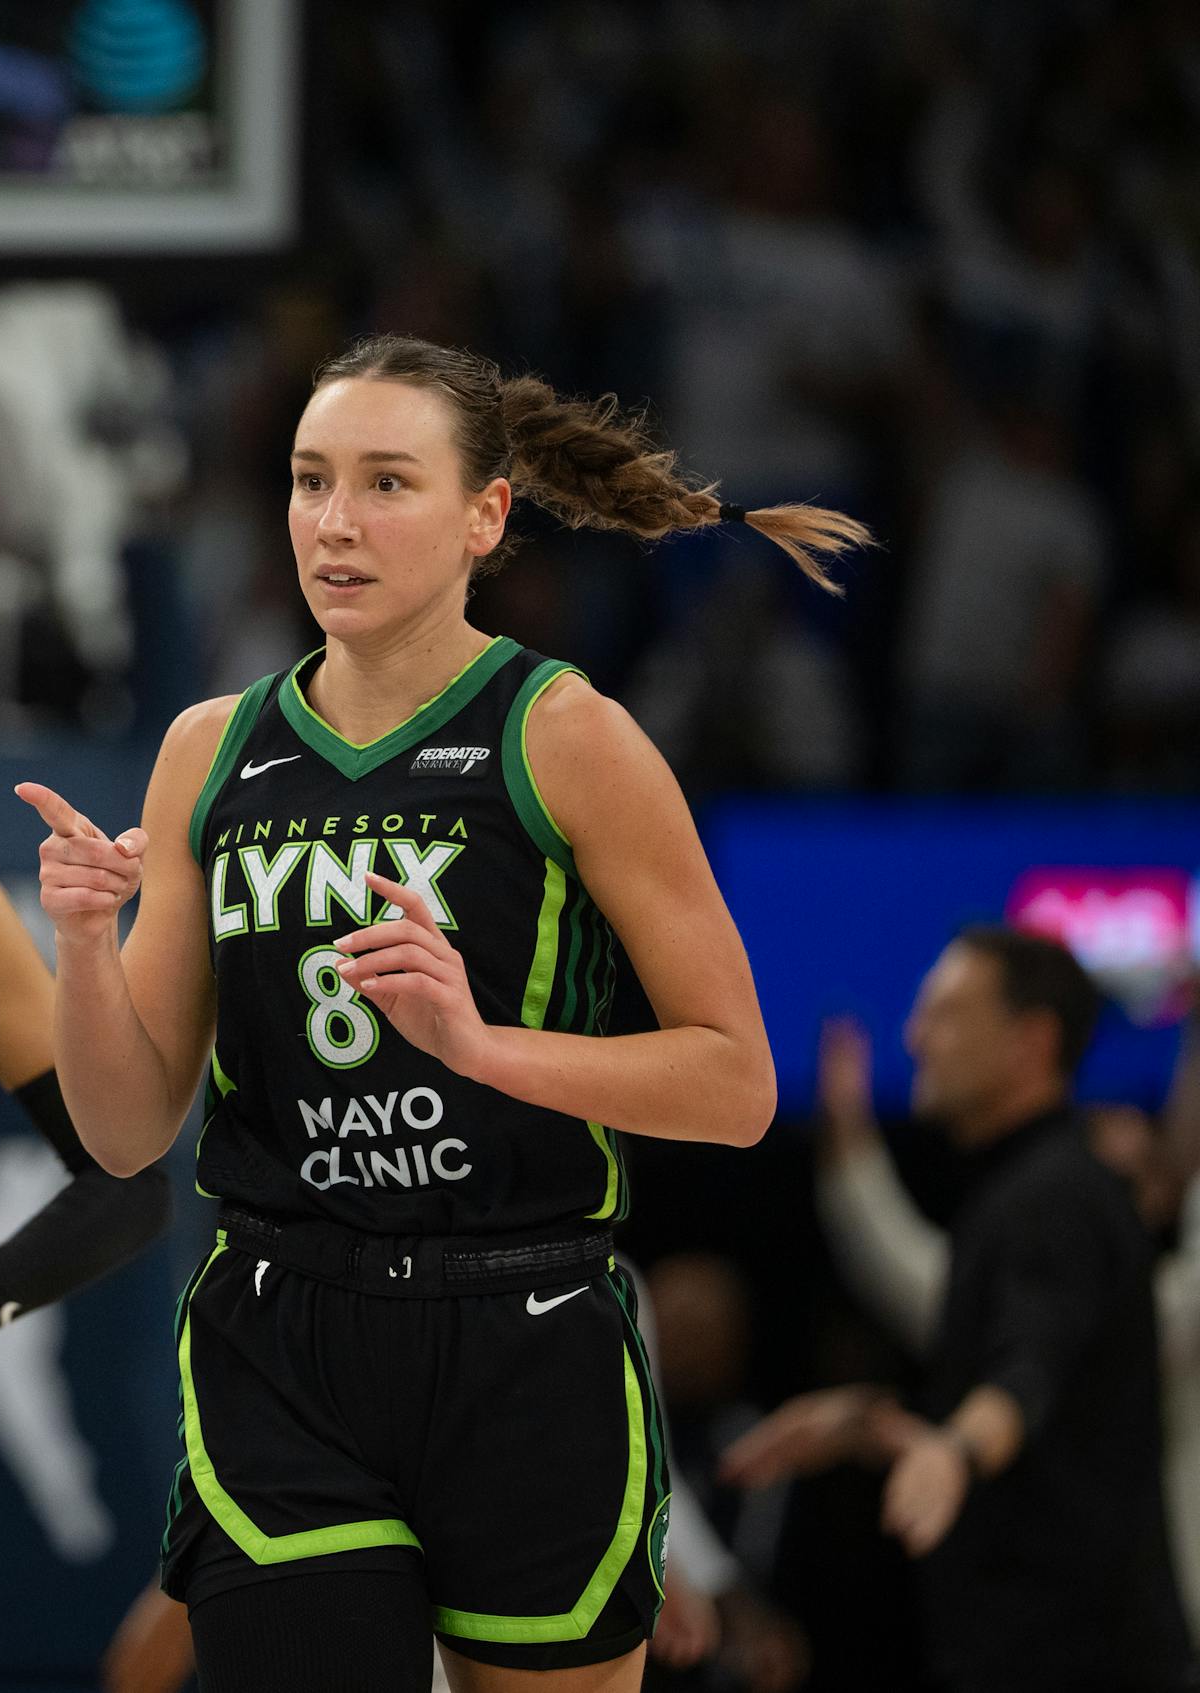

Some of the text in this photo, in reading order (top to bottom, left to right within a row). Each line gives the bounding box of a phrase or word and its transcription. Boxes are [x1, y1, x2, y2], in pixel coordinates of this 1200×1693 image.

[416, 746, 491, 760] FEDERATED
[214, 814, 468, 851] MINNESOTA
[211, 838, 467, 943] LYNX
[298, 944, 380, 1070] 8
[297, 1086, 444, 1139] MAYO
[300, 1137, 473, 1191] CLINIC
